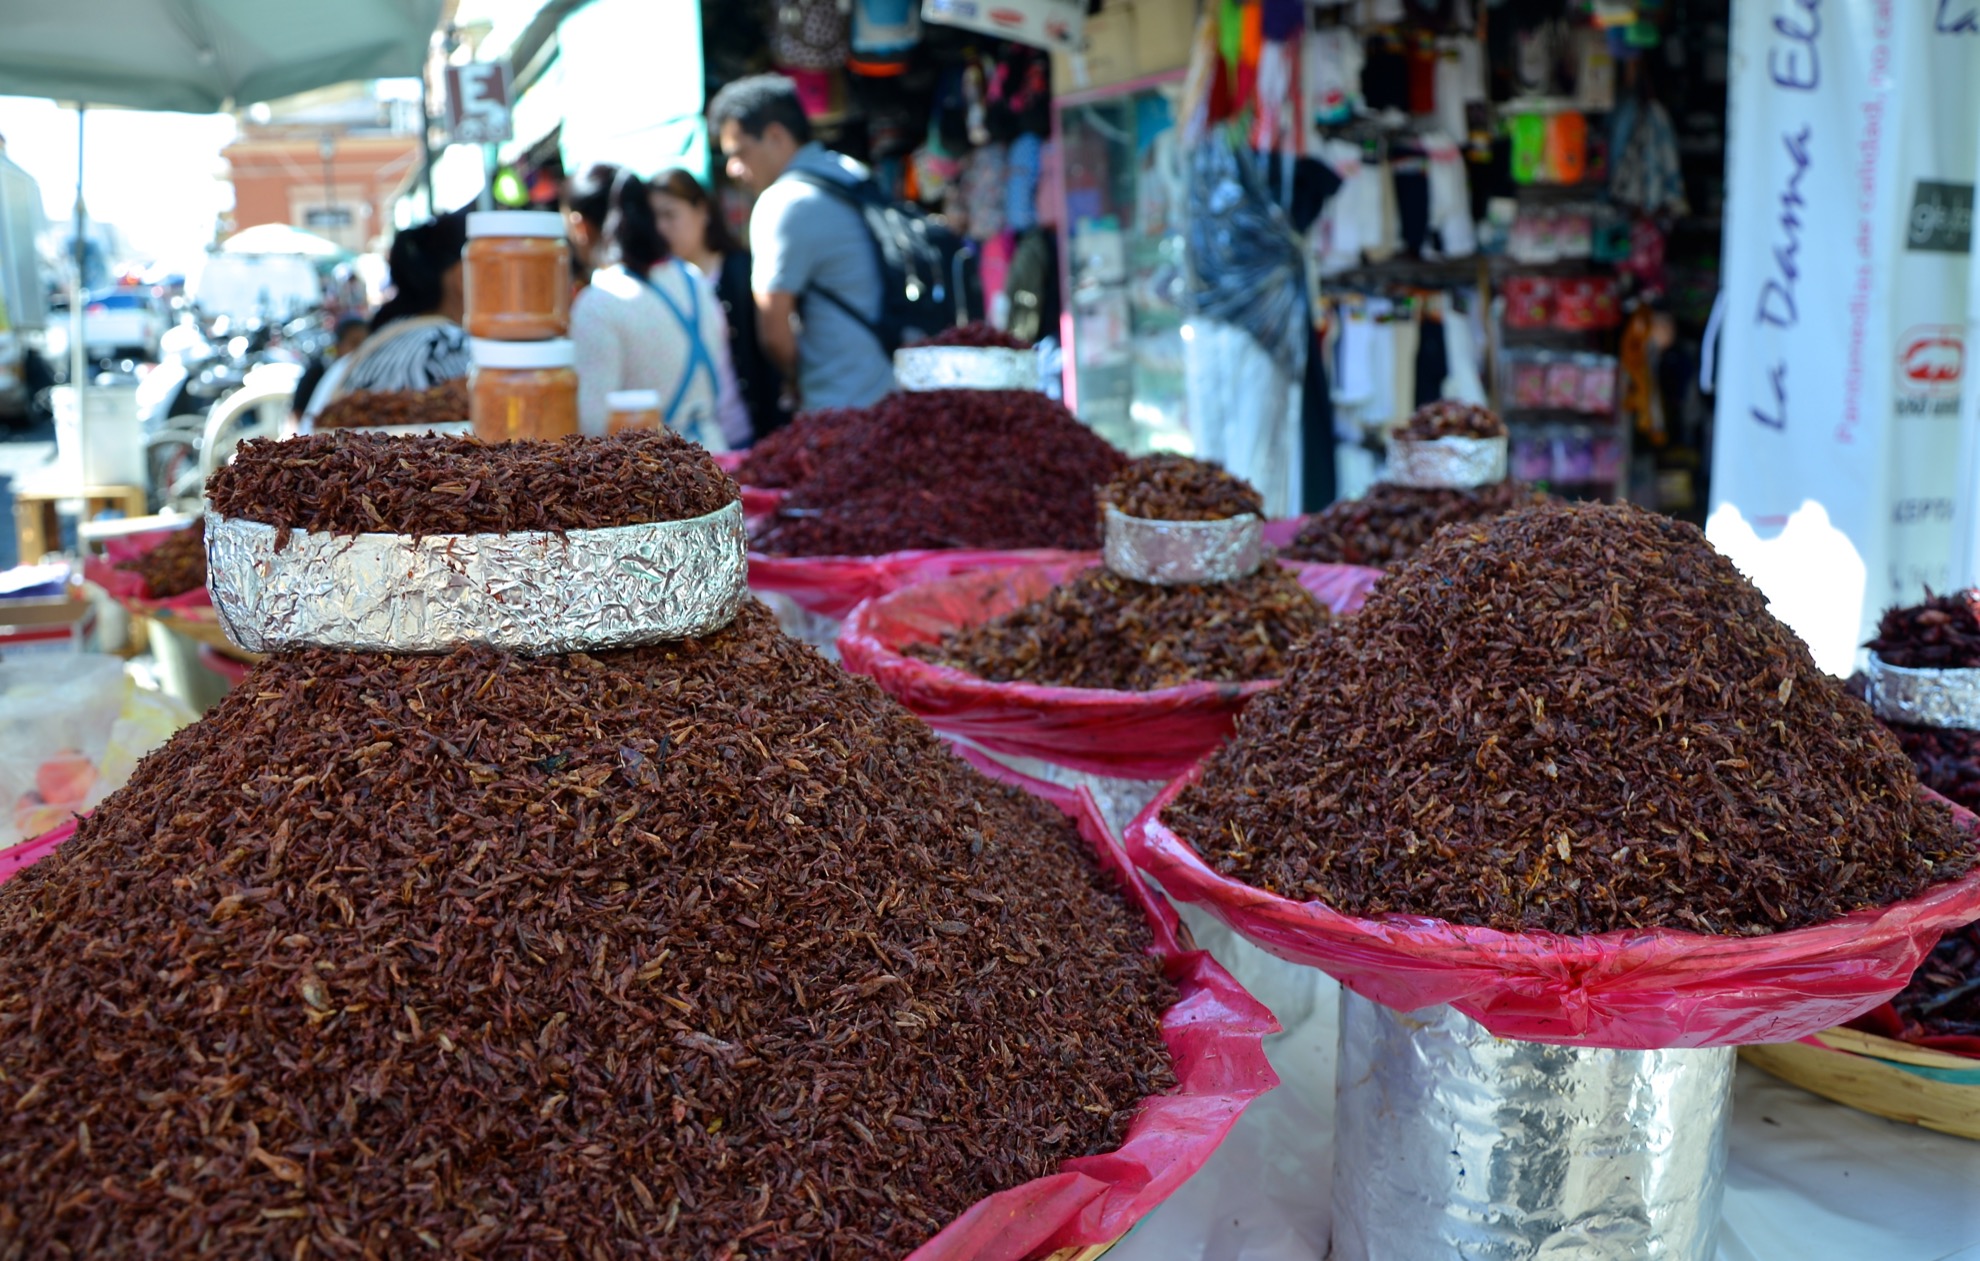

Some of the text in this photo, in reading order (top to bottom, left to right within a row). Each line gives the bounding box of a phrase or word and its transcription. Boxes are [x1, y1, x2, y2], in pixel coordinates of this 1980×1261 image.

[1756, 125, 1811, 328] Dama
[1855, 219, 1874, 259] de
[1750, 359, 1788, 432] La
